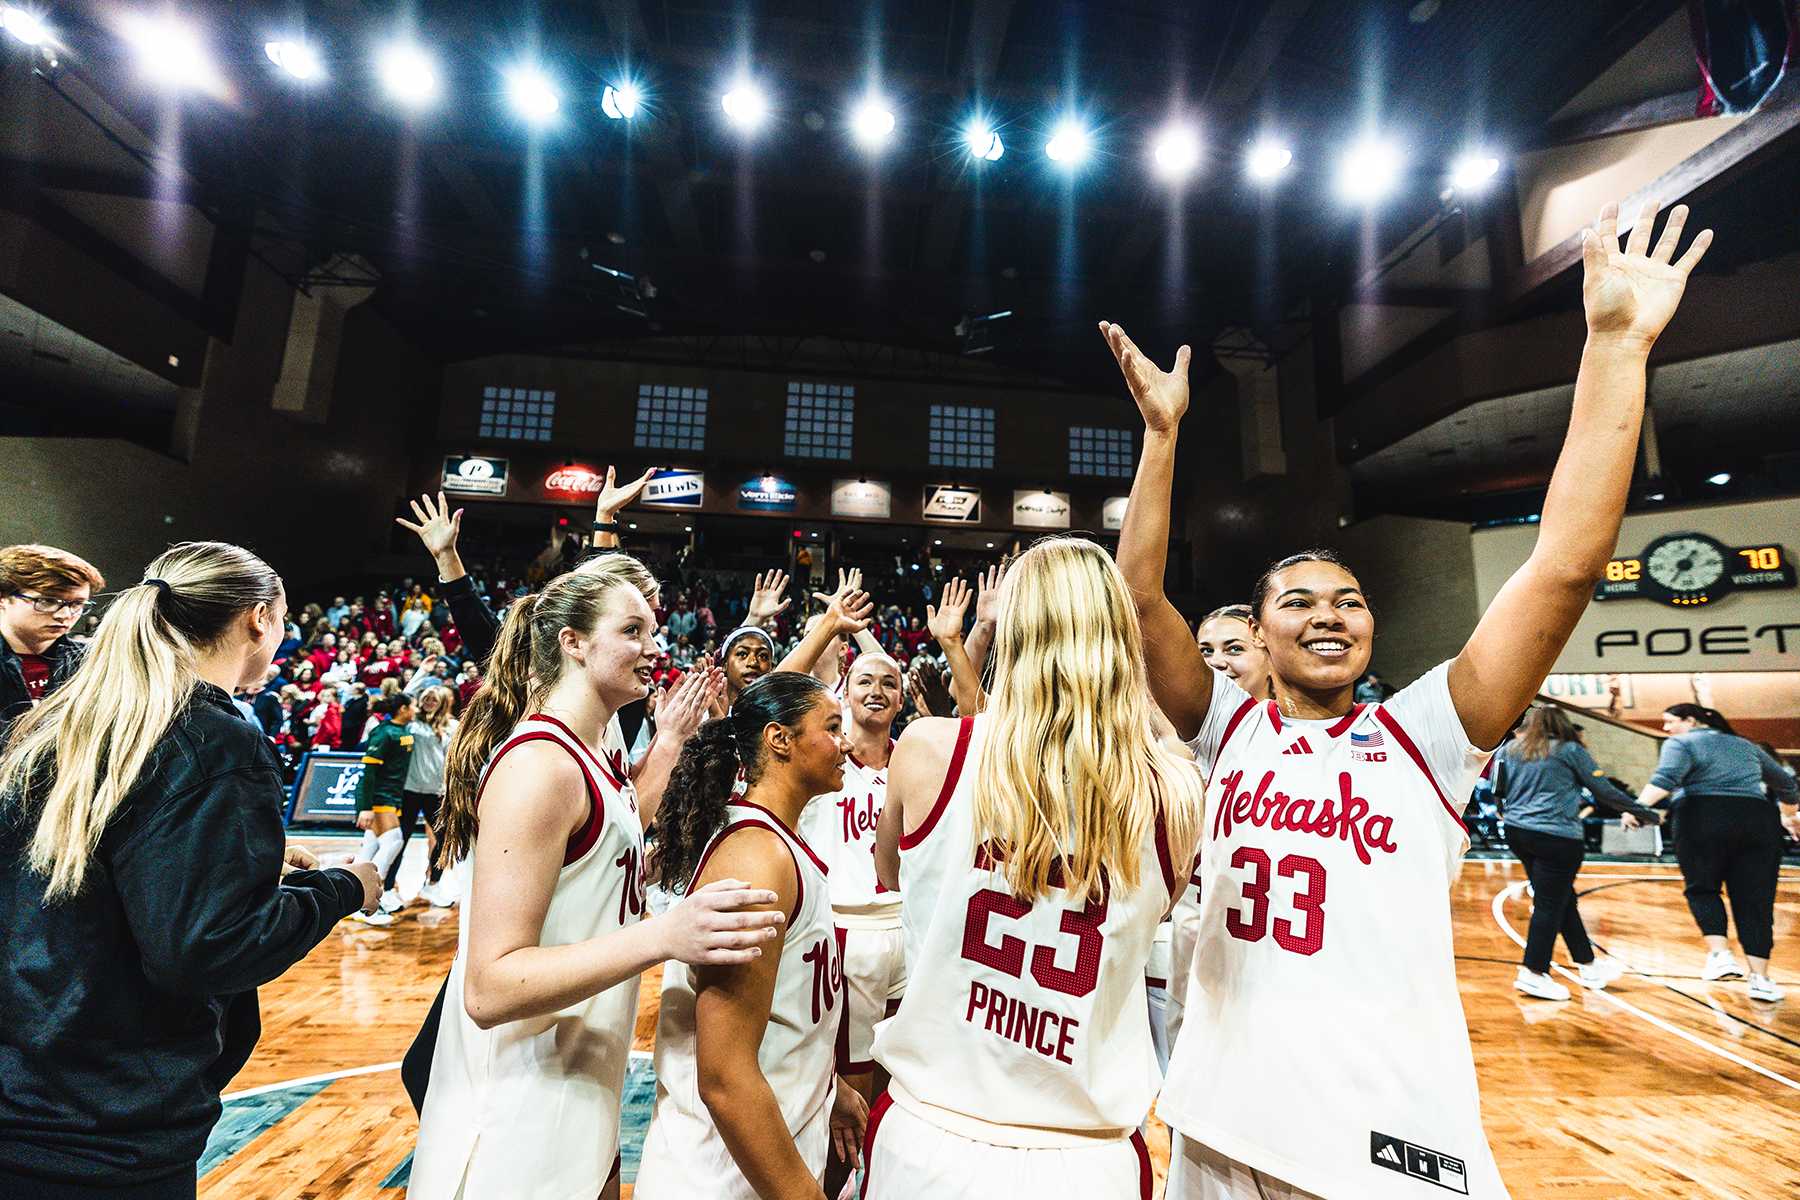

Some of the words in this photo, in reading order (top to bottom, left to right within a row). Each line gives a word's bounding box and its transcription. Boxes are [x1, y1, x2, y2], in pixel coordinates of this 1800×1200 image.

[1606, 559, 1641, 582] 82
[1738, 547, 1780, 570] 70
[1595, 623, 1800, 658] POET
[1213, 770, 1398, 865] Nebraska
[961, 837, 1111, 998] 23
[1226, 846, 1327, 956] 33
[965, 980, 1080, 1066] PRINCE
